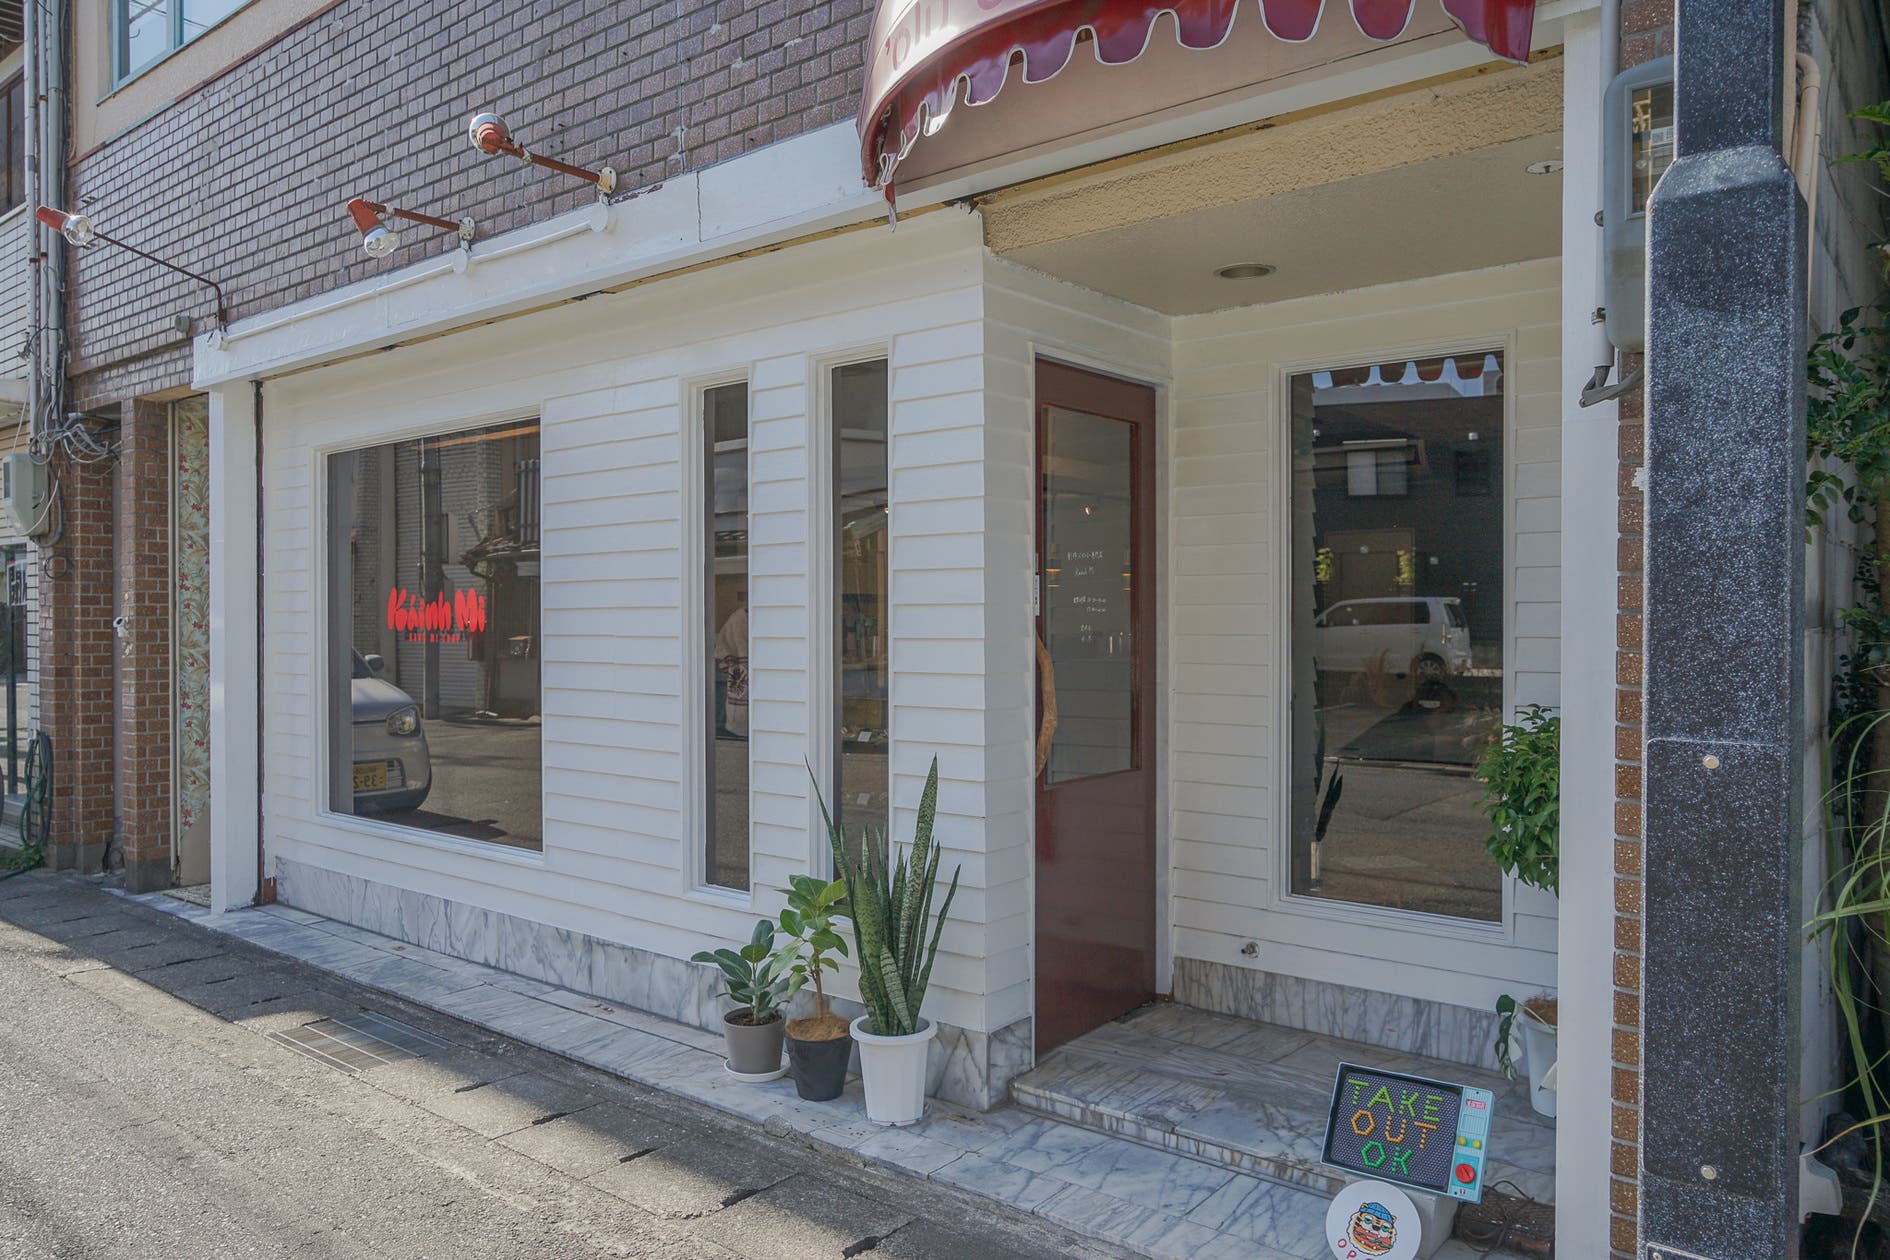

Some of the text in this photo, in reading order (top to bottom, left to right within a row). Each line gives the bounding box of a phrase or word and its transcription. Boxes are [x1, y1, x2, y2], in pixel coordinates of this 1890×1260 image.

[1348, 1079, 1444, 1122] TAKE
[1351, 1110, 1438, 1149] OUT
[1361, 1141, 1414, 1175] OK
[1337, 1238, 1374, 1260] OP
